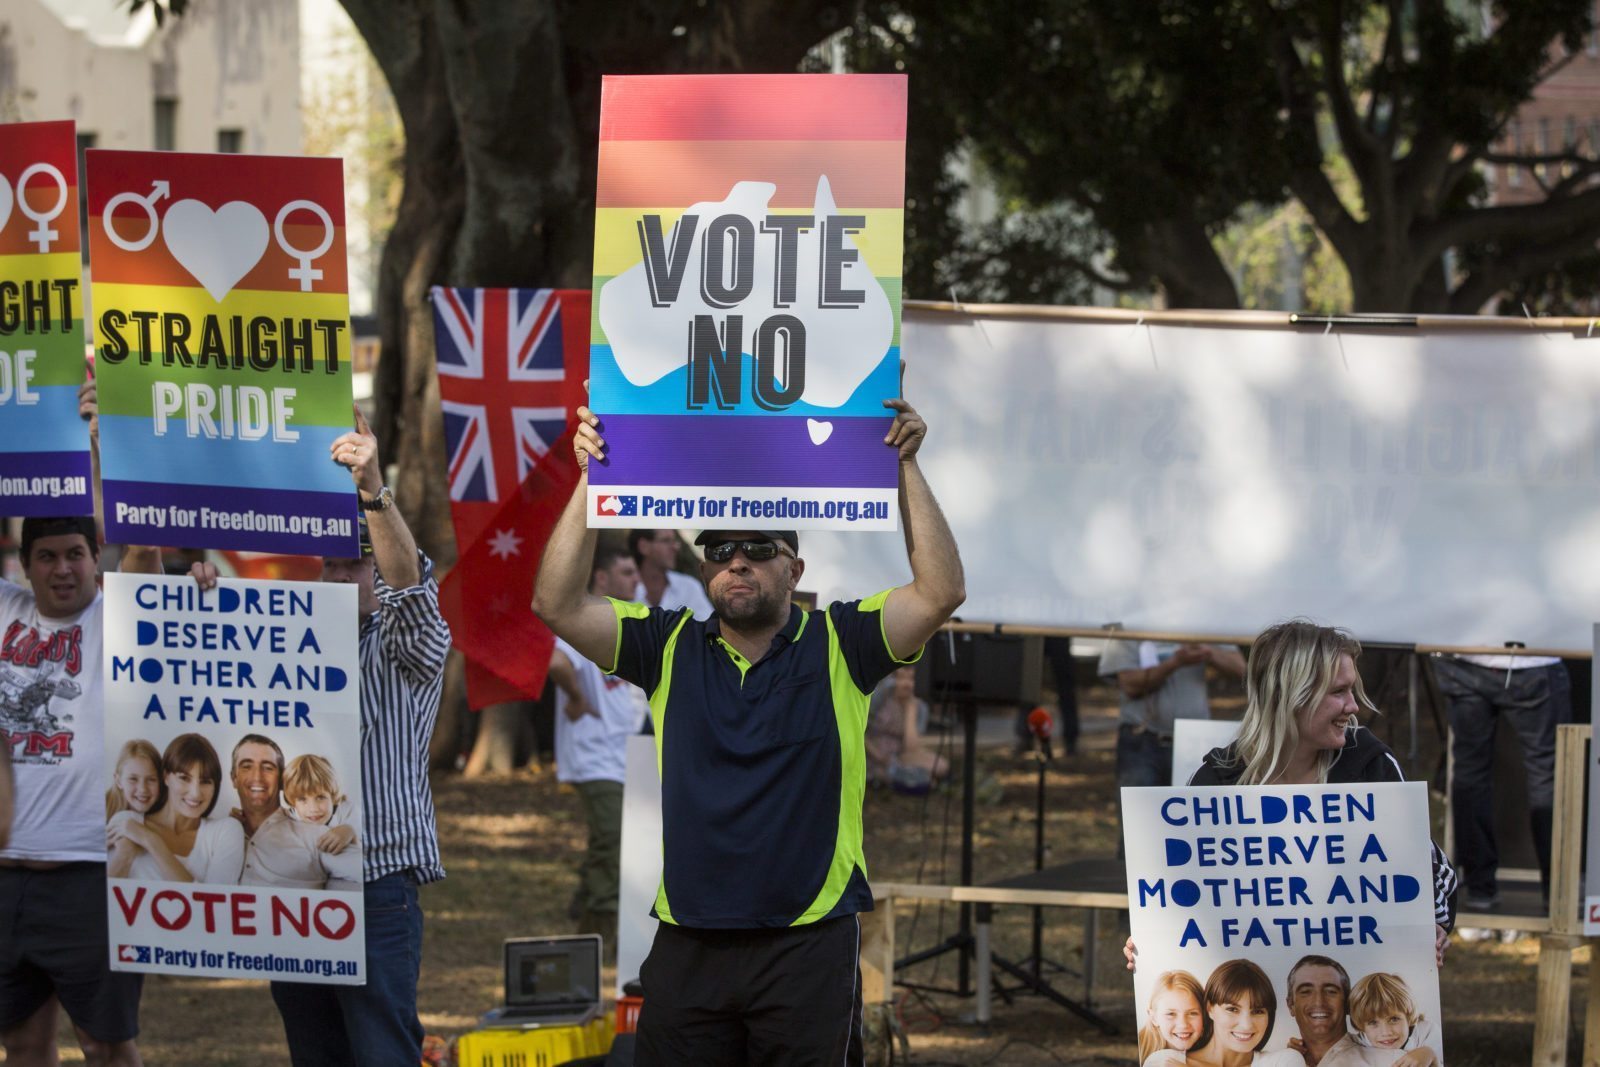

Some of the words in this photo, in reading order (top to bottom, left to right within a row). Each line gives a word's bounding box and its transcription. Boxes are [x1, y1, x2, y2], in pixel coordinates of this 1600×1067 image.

[637, 214, 866, 309] VOTE
[99, 309, 346, 375] STRAIGHT
[686, 314, 807, 412] NO
[152, 381, 300, 443] PRIDE
[116, 502, 166, 527] Party
[169, 506, 198, 527] for
[201, 508, 352, 539] Freedom.org.au
[642, 496, 696, 519] Party
[699, 496, 728, 517] for
[731, 497, 888, 521] Freedom.org.au
[136, 584, 313, 616] CHILDREN
[137, 621, 286, 653] DESERVE
[298, 628, 321, 654] A
[112, 656, 256, 688] MOTHER
[269, 663, 348, 692] AND
[143, 694, 166, 720] A
[180, 696, 314, 728] FATHER
[1161, 793, 1375, 826] CHILDREN
[1165, 835, 1346, 867] DESERVE
[1360, 834, 1388, 863] A
[1138, 876, 1313, 907] MOTHER
[1327, 875, 1420, 904] AND
[113, 886, 256, 936] VOTE
[272, 895, 356, 940] NO
[1180, 918, 1207, 947] A
[1222, 916, 1383, 947] FATHER
[154, 949, 198, 969] Party
[201, 950, 224, 968] for
[228, 951, 357, 976] Freedom.org.au
